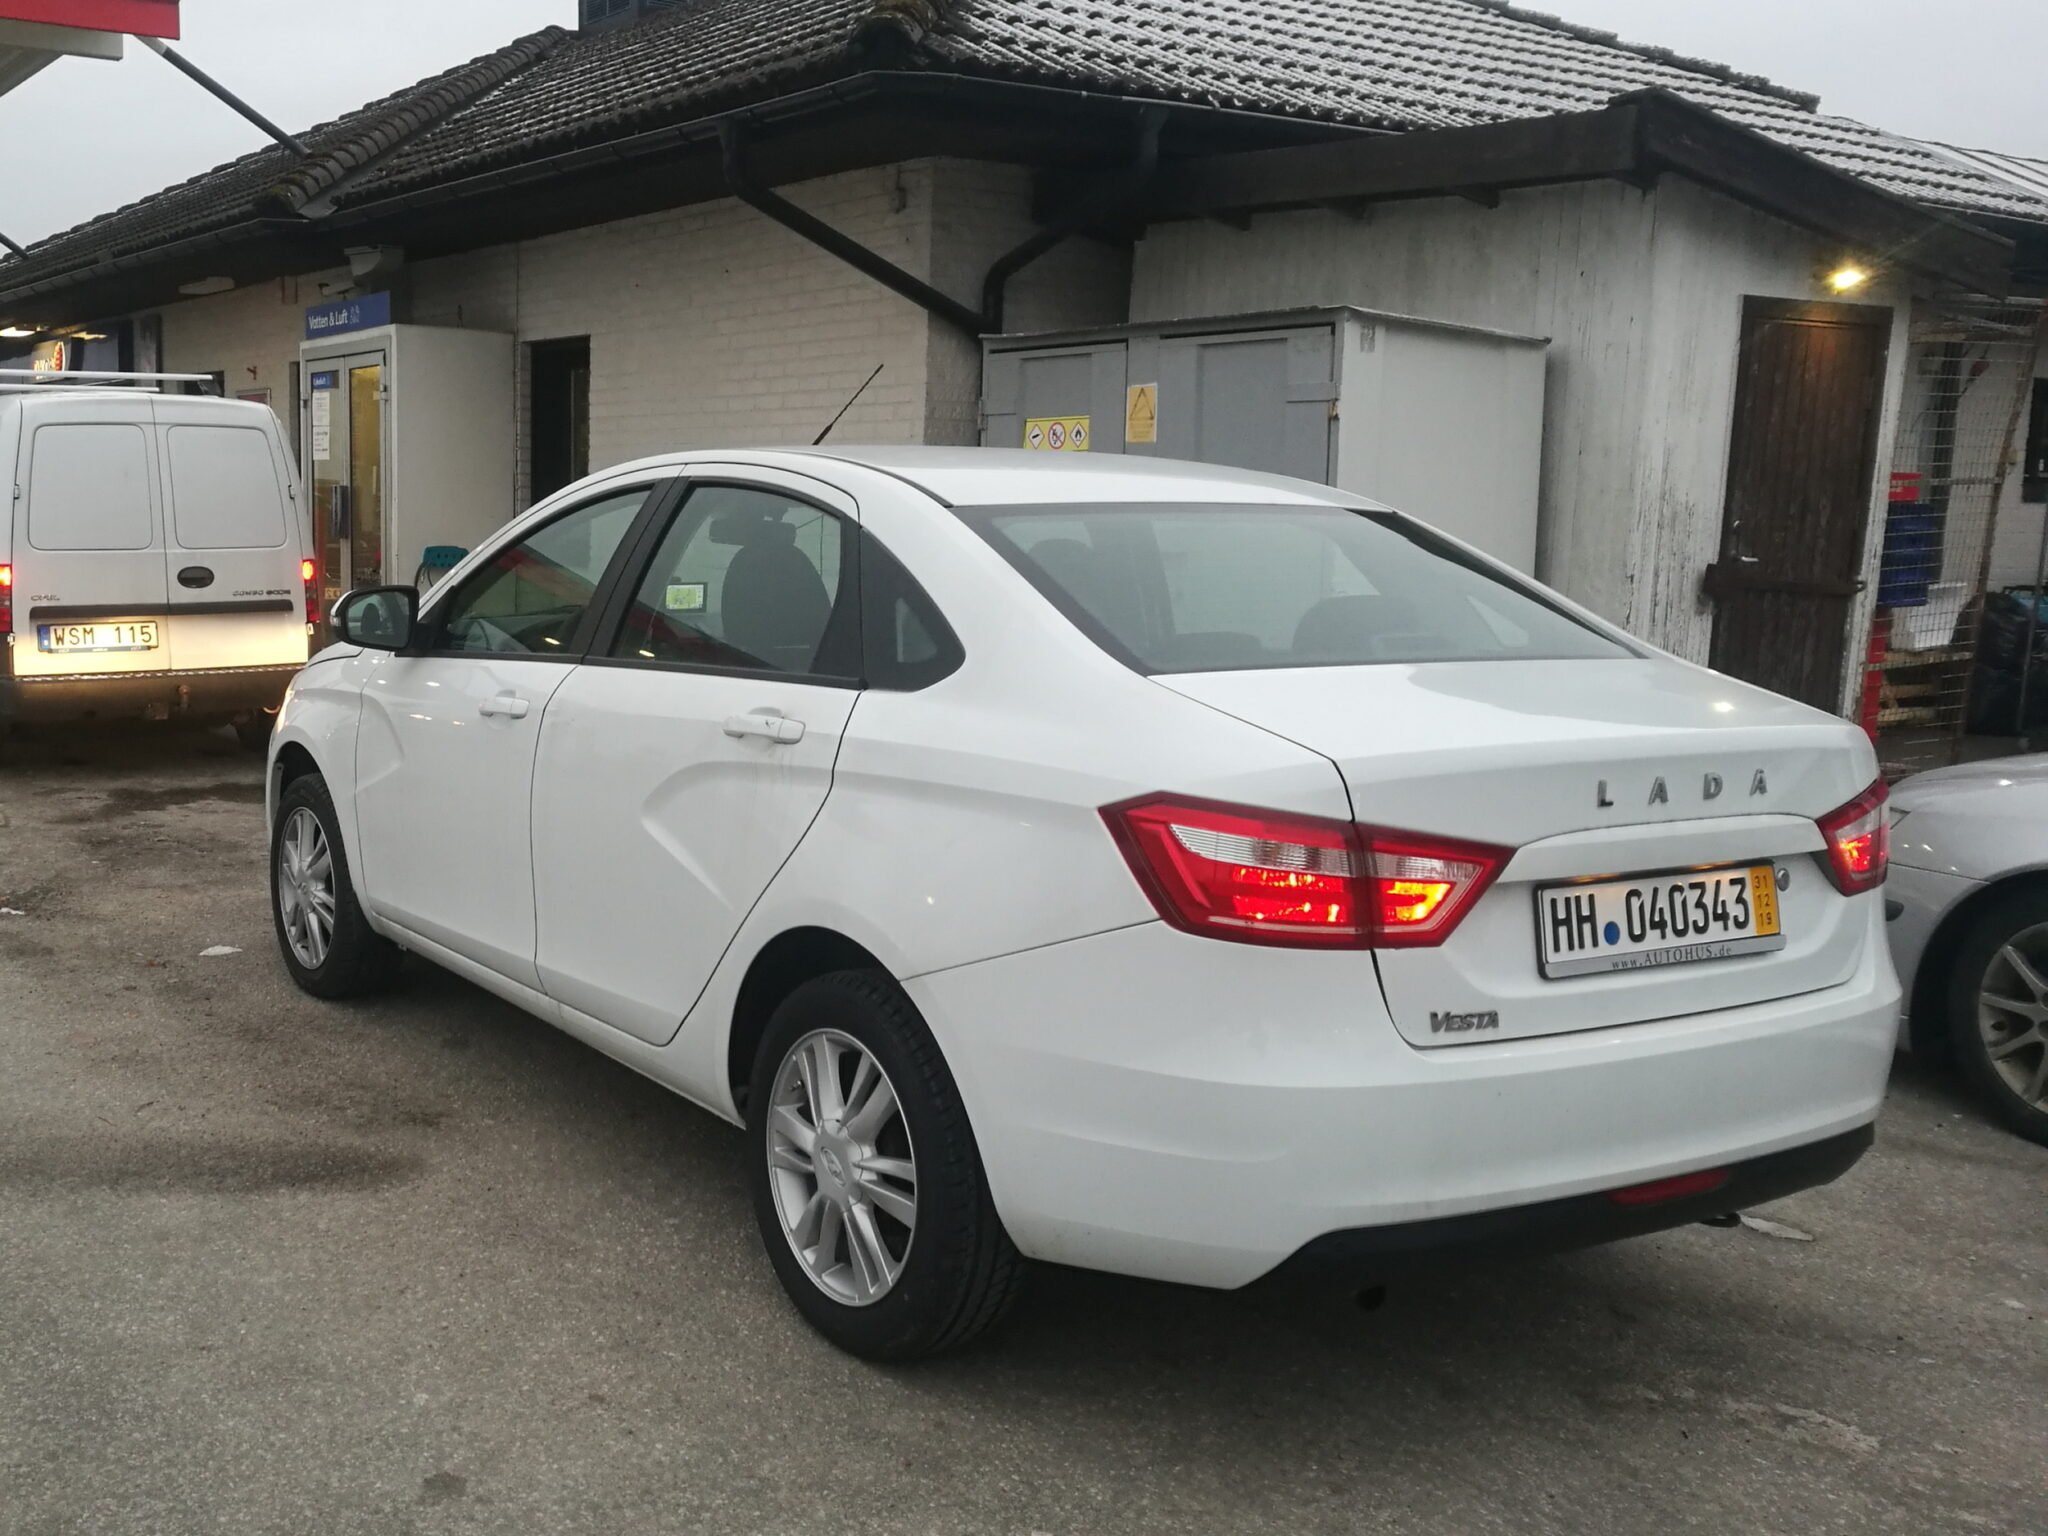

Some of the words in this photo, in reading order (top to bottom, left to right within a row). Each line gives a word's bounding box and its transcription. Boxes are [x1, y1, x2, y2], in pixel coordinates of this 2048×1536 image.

[308, 315, 328, 330] Vatten
[329, 311, 334, 326] &
[335, 308, 348, 325] Luft
[53, 627, 94, 646] WSM
[115, 625, 152, 643] 115
[1597, 768, 1768, 808] LADA
[1754, 875, 1768, 889] 31
[1757, 893, 1771, 908] 12
[1550, 892, 1599, 952] HH
[1625, 876, 1749, 943] 040343
[1759, 911, 1772, 927] 19
[1611, 944, 1732, 970] www.AUTOHUS.de
